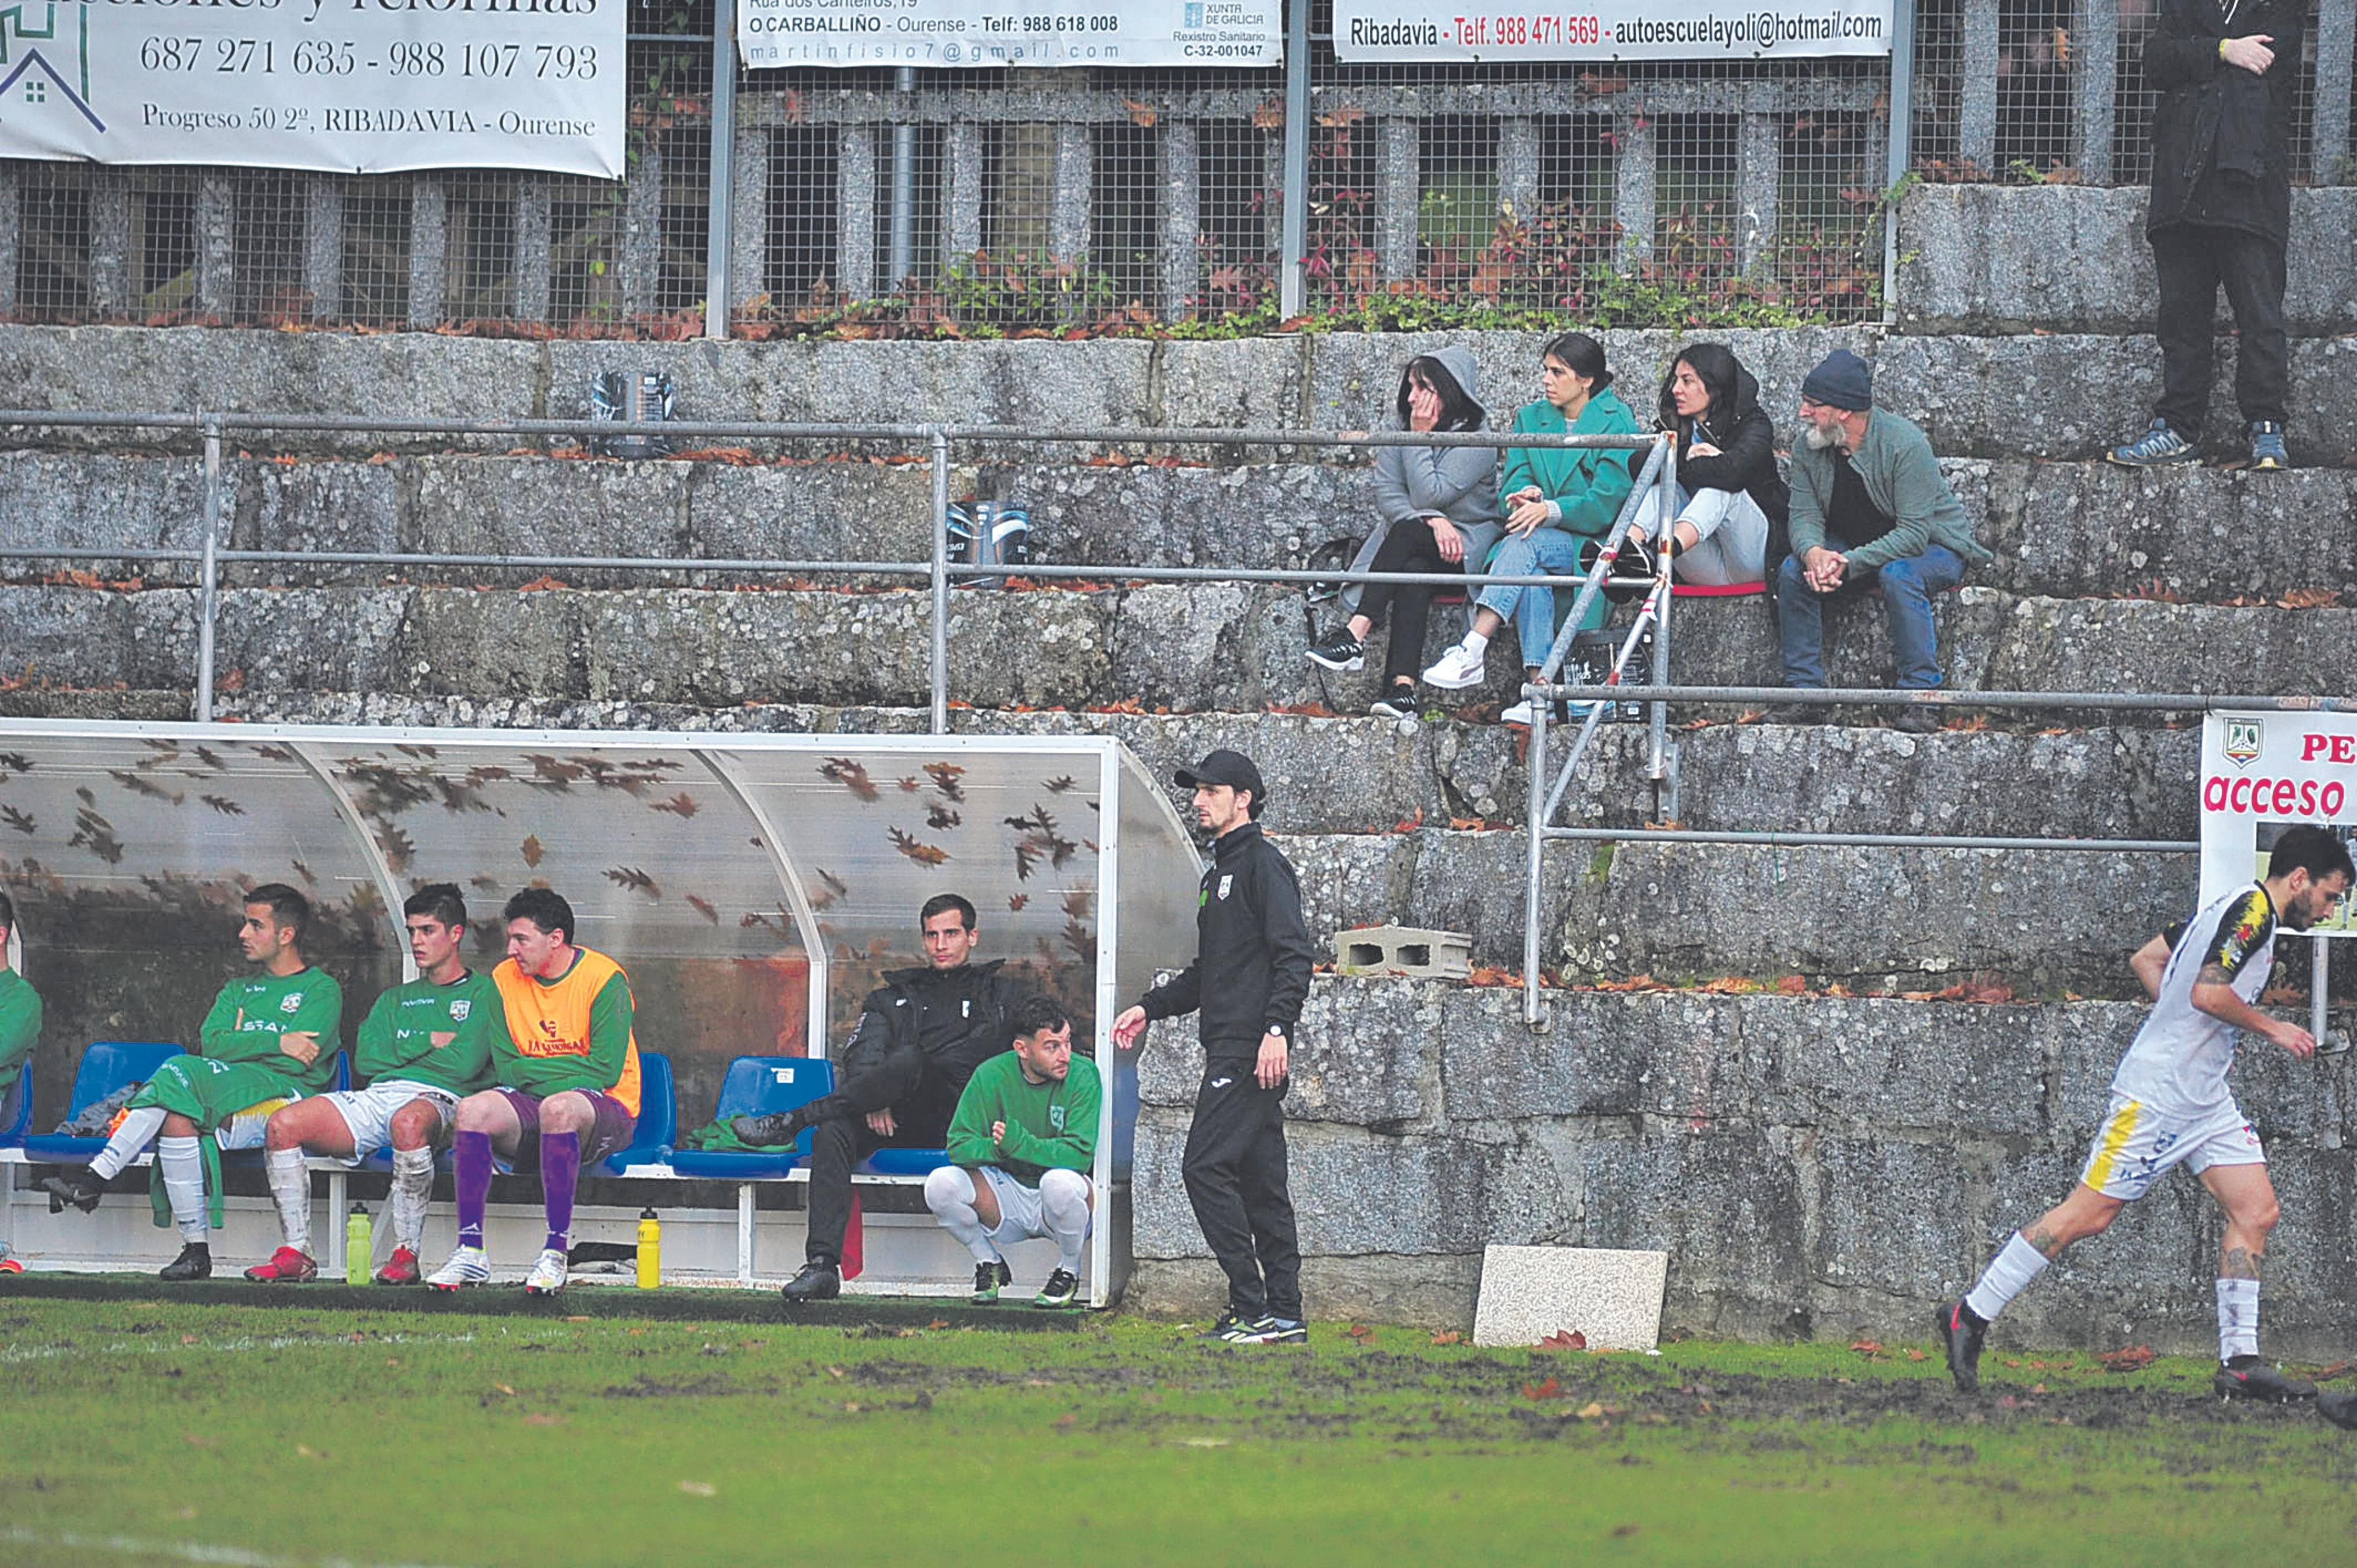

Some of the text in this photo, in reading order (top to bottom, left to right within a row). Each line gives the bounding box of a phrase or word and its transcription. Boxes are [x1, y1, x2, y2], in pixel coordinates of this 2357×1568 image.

[1207, 4, 1241, 13] XUNTA
[767, 14, 880, 31] CARBALLIÑO
[898, 16, 965, 32] Ourense
[982, 16, 1017, 32] Telf:
[1023, 16, 1051, 32] 988
[1056, 16, 1084, 32] 618
[1091, 15, 1118, 31] 008
[1206, 15, 1263, 24] DE GALICIA
[1173, 31, 1265, 42] Rexistro Sanitario
[1351, 18, 1437, 45] Ribadavia
[1454, 18, 1490, 45] Telf.
[1496, 17, 1526, 45] 988
[1532, 17, 1561, 44] 471
[1568, 16, 1599, 44] 569
[1615, 10, 1882, 49] autoescuelayoli@hotmail.com
[141, 37, 202, 71] 687
[217, 38, 274, 72] 271
[293, 41, 354, 75] 635
[390, 42, 445, 77] 988
[463, 43, 520, 78] 107
[535, 45, 597, 80] 793
[750, 42, 1118, 62] martinfisio7@gmail.com
[1185, 45, 1262, 56] C-32-001047
[143, 103, 241, 133] Progreso
[248, 107, 275, 129] 50
[324, 108, 477, 132] RIBADAVIA
[499, 111, 596, 137] Ourense
[2204, 776, 2344, 817] acceso
